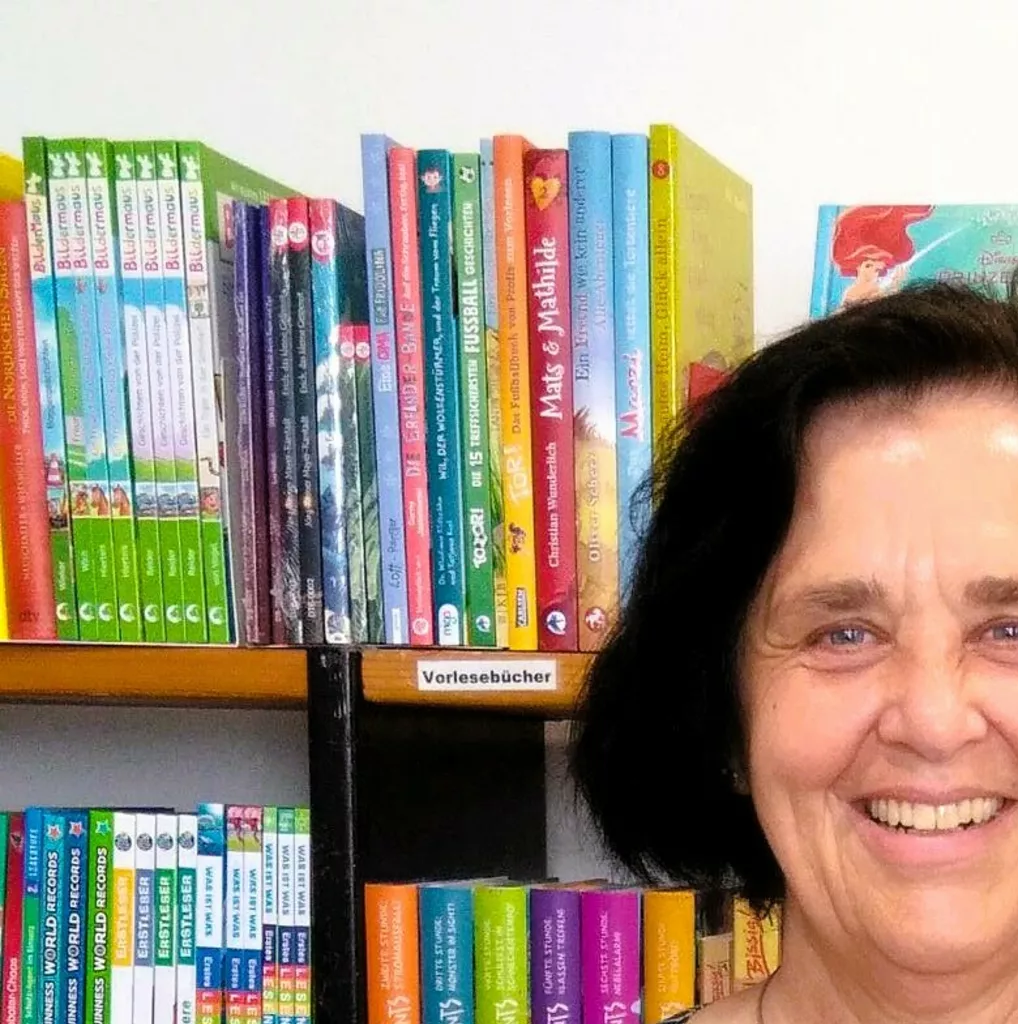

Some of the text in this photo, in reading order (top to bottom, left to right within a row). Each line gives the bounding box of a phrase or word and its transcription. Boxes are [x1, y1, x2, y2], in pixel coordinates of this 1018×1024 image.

[53, 186, 71, 269] Bildermaus
[70, 185, 88, 269] Bildermaus
[92, 185, 109, 269] Bildermaus
[120, 187, 137, 271] Bildermaus
[653, 218, 668, 265] allein
[428, 203, 442, 332] und der Traum Fliegen
[572, 229, 590, 381] Ein Freund wie kein
[462, 203, 484, 487] DIE 15 FUSSBALL GESCHICHTEN
[532, 237, 565, 568] Christian Wunderlich Mats & Mathilde
[422, 670, 552, 684] Vorlesebücher
[46, 851, 59, 912] RECORDS
[69, 848, 81, 908] RECORDS
[95, 847, 107, 908] RECORDS
[297, 845, 306, 869] WAS
[42, 917, 58, 975] WORLD
[66, 913, 81, 971] WORLD
[93, 912, 107, 971] WORLD
[158, 876, 170, 958] ERSTLESER
